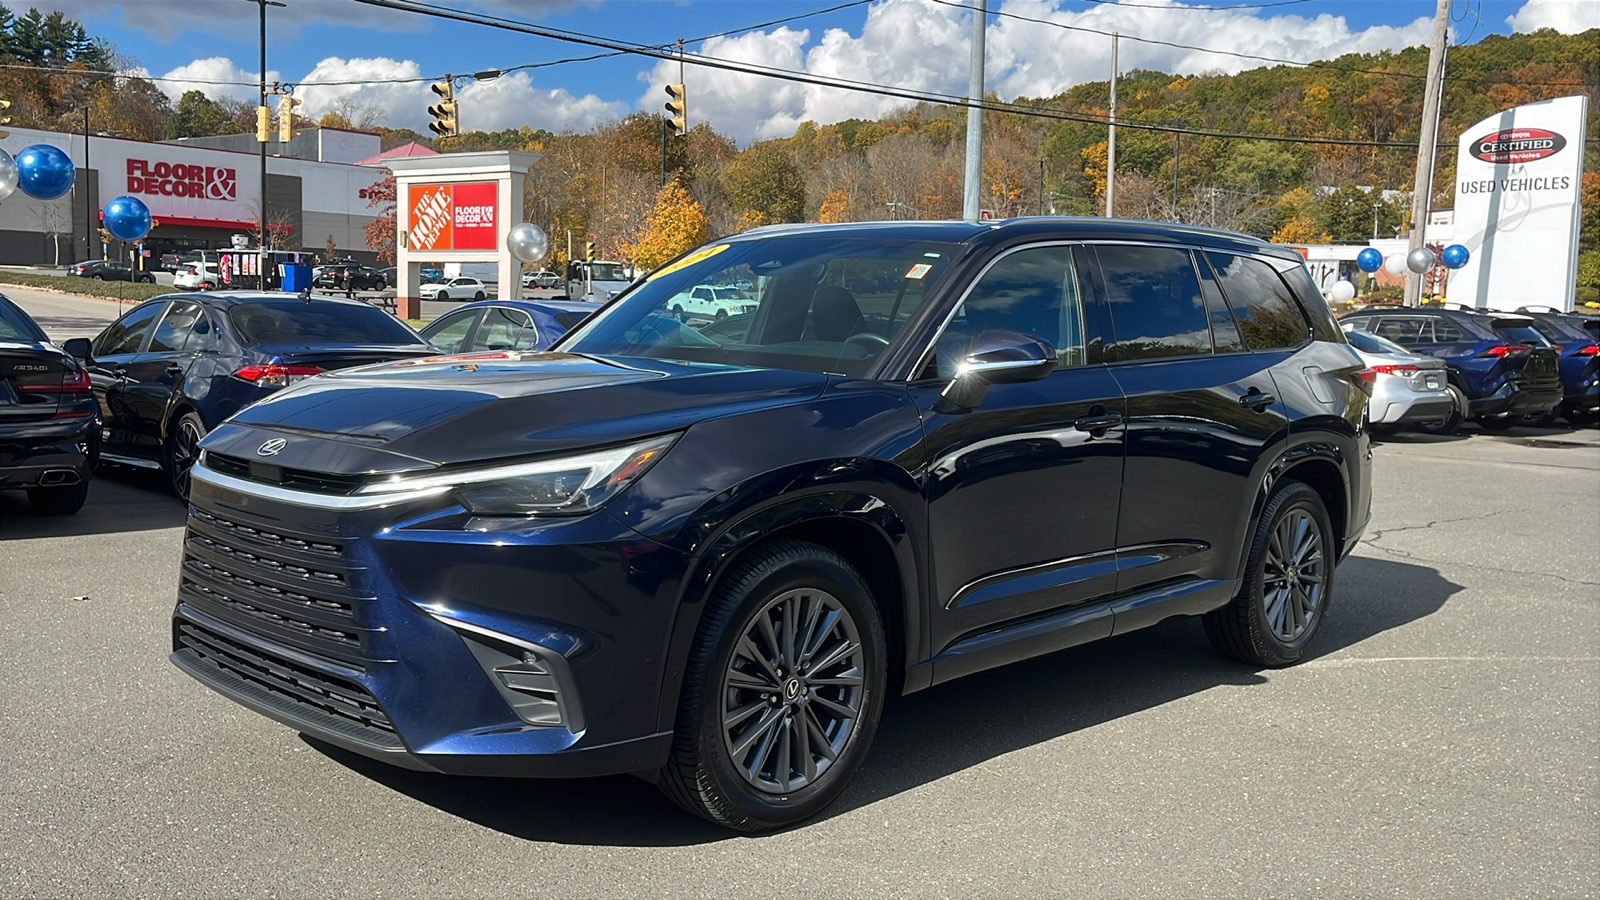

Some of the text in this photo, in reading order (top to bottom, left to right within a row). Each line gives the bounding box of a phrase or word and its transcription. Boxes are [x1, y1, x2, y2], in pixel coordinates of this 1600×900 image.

[1480, 140, 1554, 153] CERTIFIED
[1509, 152, 1541, 160] Vehicles
[126, 158, 204, 182] FLOOR
[127, 176, 205, 199] DECOR
[1461, 176, 1570, 194] USED VEHICLES
[412, 190, 433, 219] THE
[455, 206, 481, 215] FLOOR
[409, 186, 451, 250] HOME
[455, 214, 481, 223] DECOR
[424, 208, 451, 250] DEPOT
